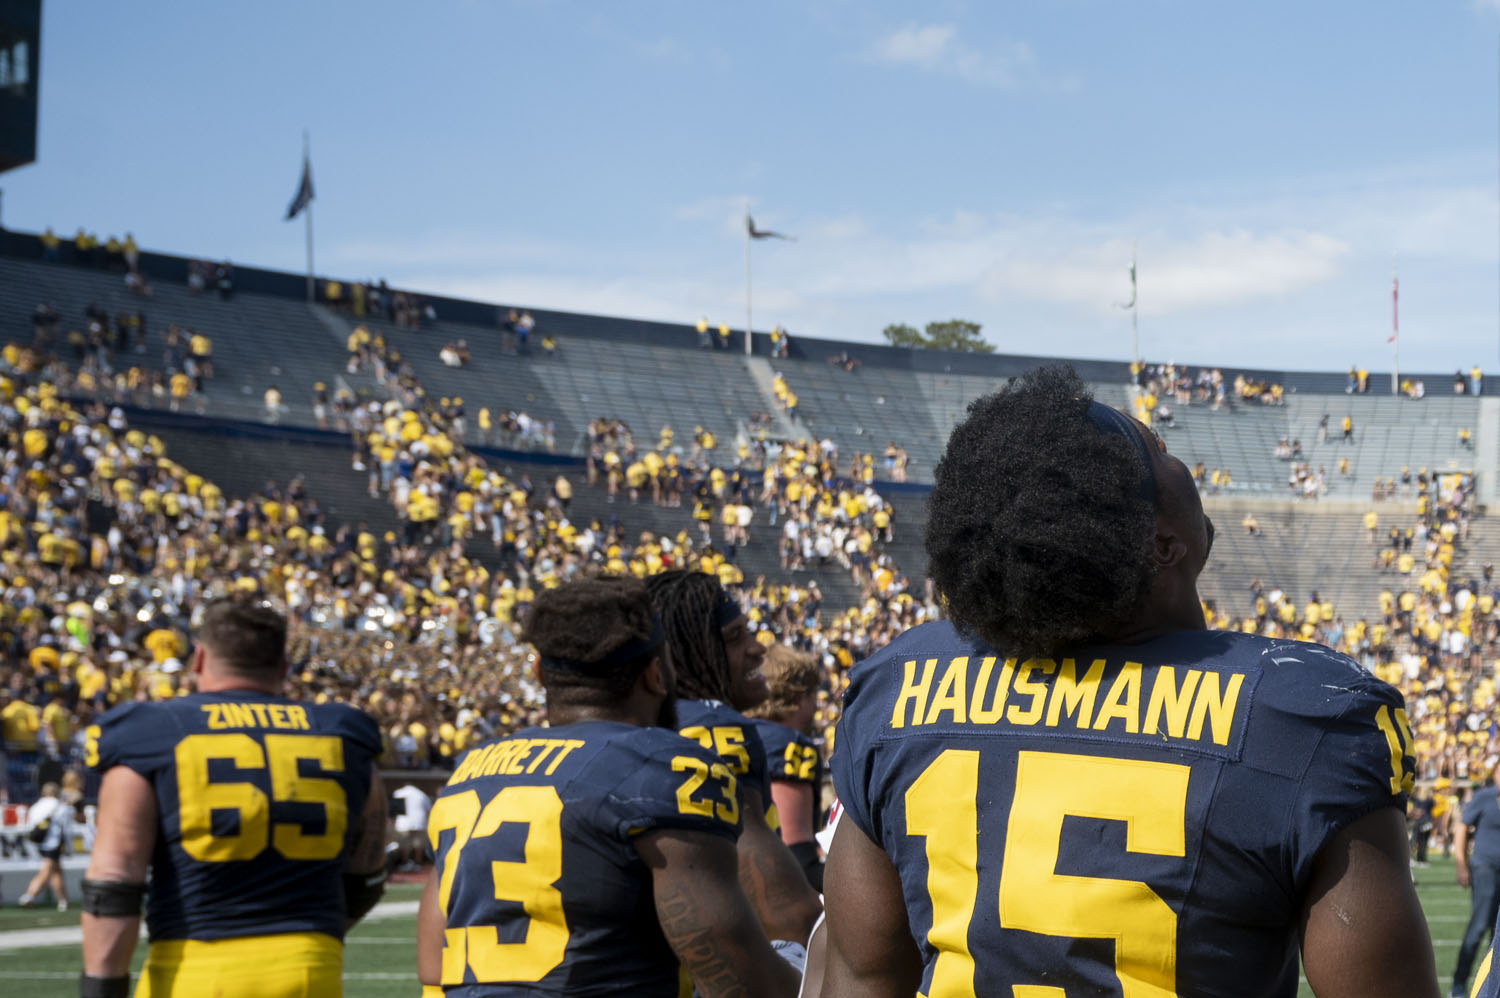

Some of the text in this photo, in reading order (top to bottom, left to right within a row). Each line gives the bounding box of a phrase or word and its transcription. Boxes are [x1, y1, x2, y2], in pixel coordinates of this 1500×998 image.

[201, 703, 311, 730] ZINTER
[891, 655, 1244, 745] HAUSMANN
[174, 733, 348, 862] 65
[447, 739, 586, 786] BARRETT
[670, 755, 740, 826] 23
[429, 785, 571, 985] 23
